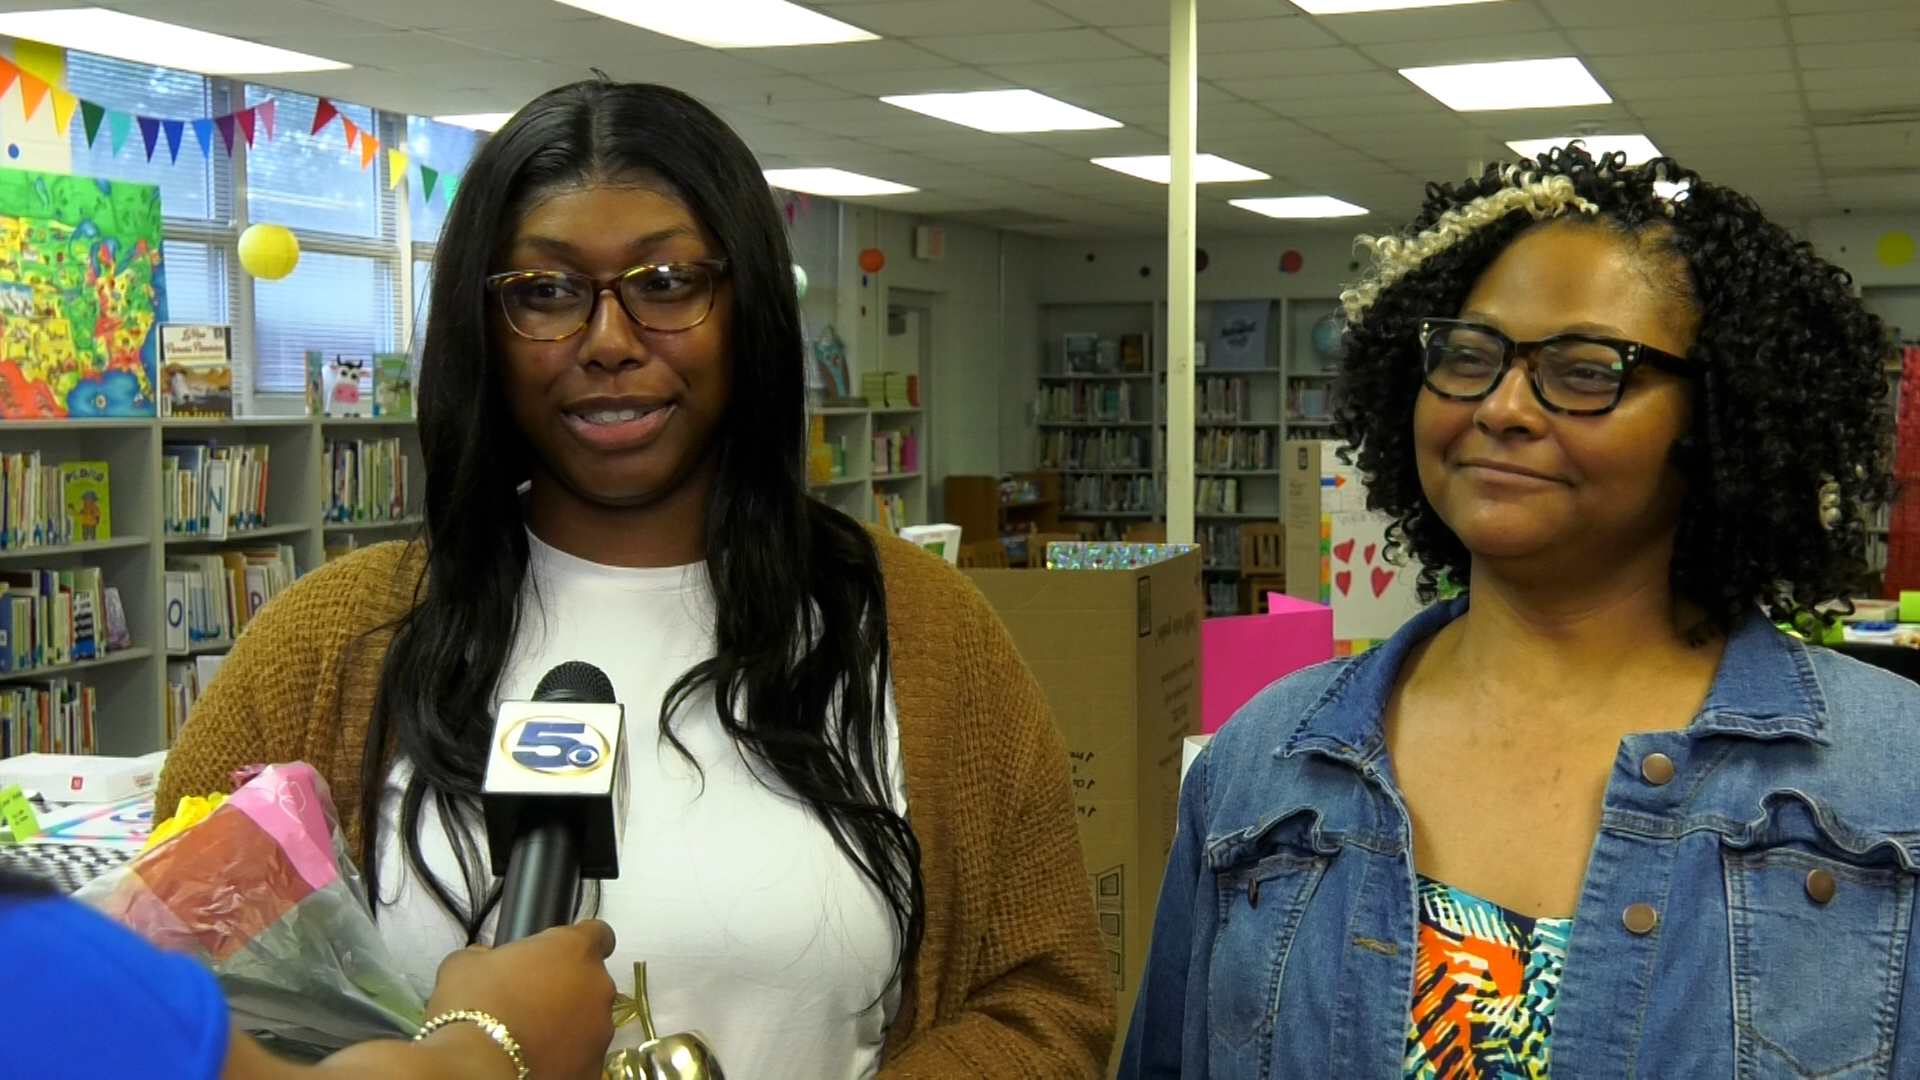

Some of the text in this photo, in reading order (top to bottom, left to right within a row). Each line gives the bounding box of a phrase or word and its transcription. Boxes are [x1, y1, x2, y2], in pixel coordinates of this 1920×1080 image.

[210, 485, 223, 514] N
[168, 598, 183, 628] O
[511, 721, 585, 768] 5
